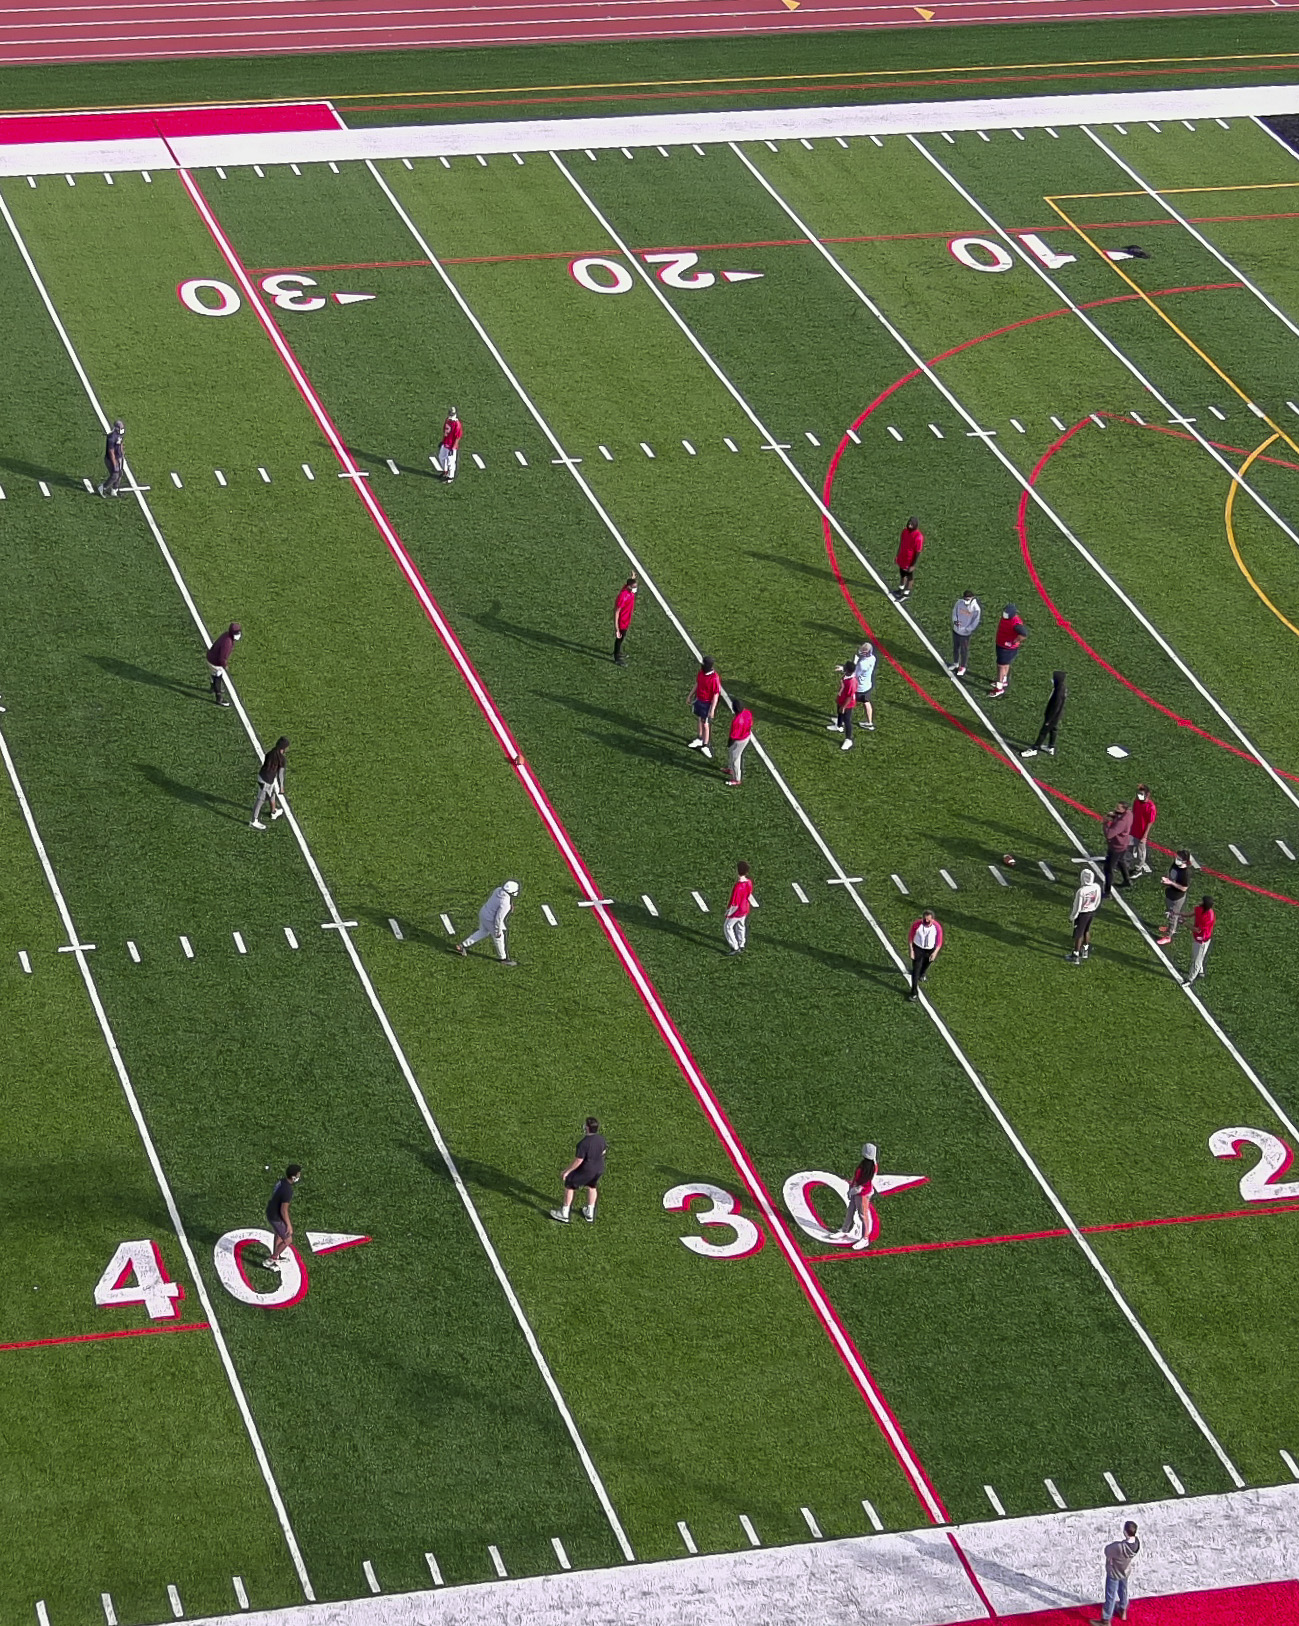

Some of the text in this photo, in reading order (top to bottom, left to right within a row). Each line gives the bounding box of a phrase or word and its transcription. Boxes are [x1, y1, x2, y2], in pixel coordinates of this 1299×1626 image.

[570, 251, 716, 295] 20
[948, 232, 1078, 273] 10
[178, 273, 327, 317] 30
[662, 1169, 882, 1262] 30
[93, 1227, 311, 1321] 40
